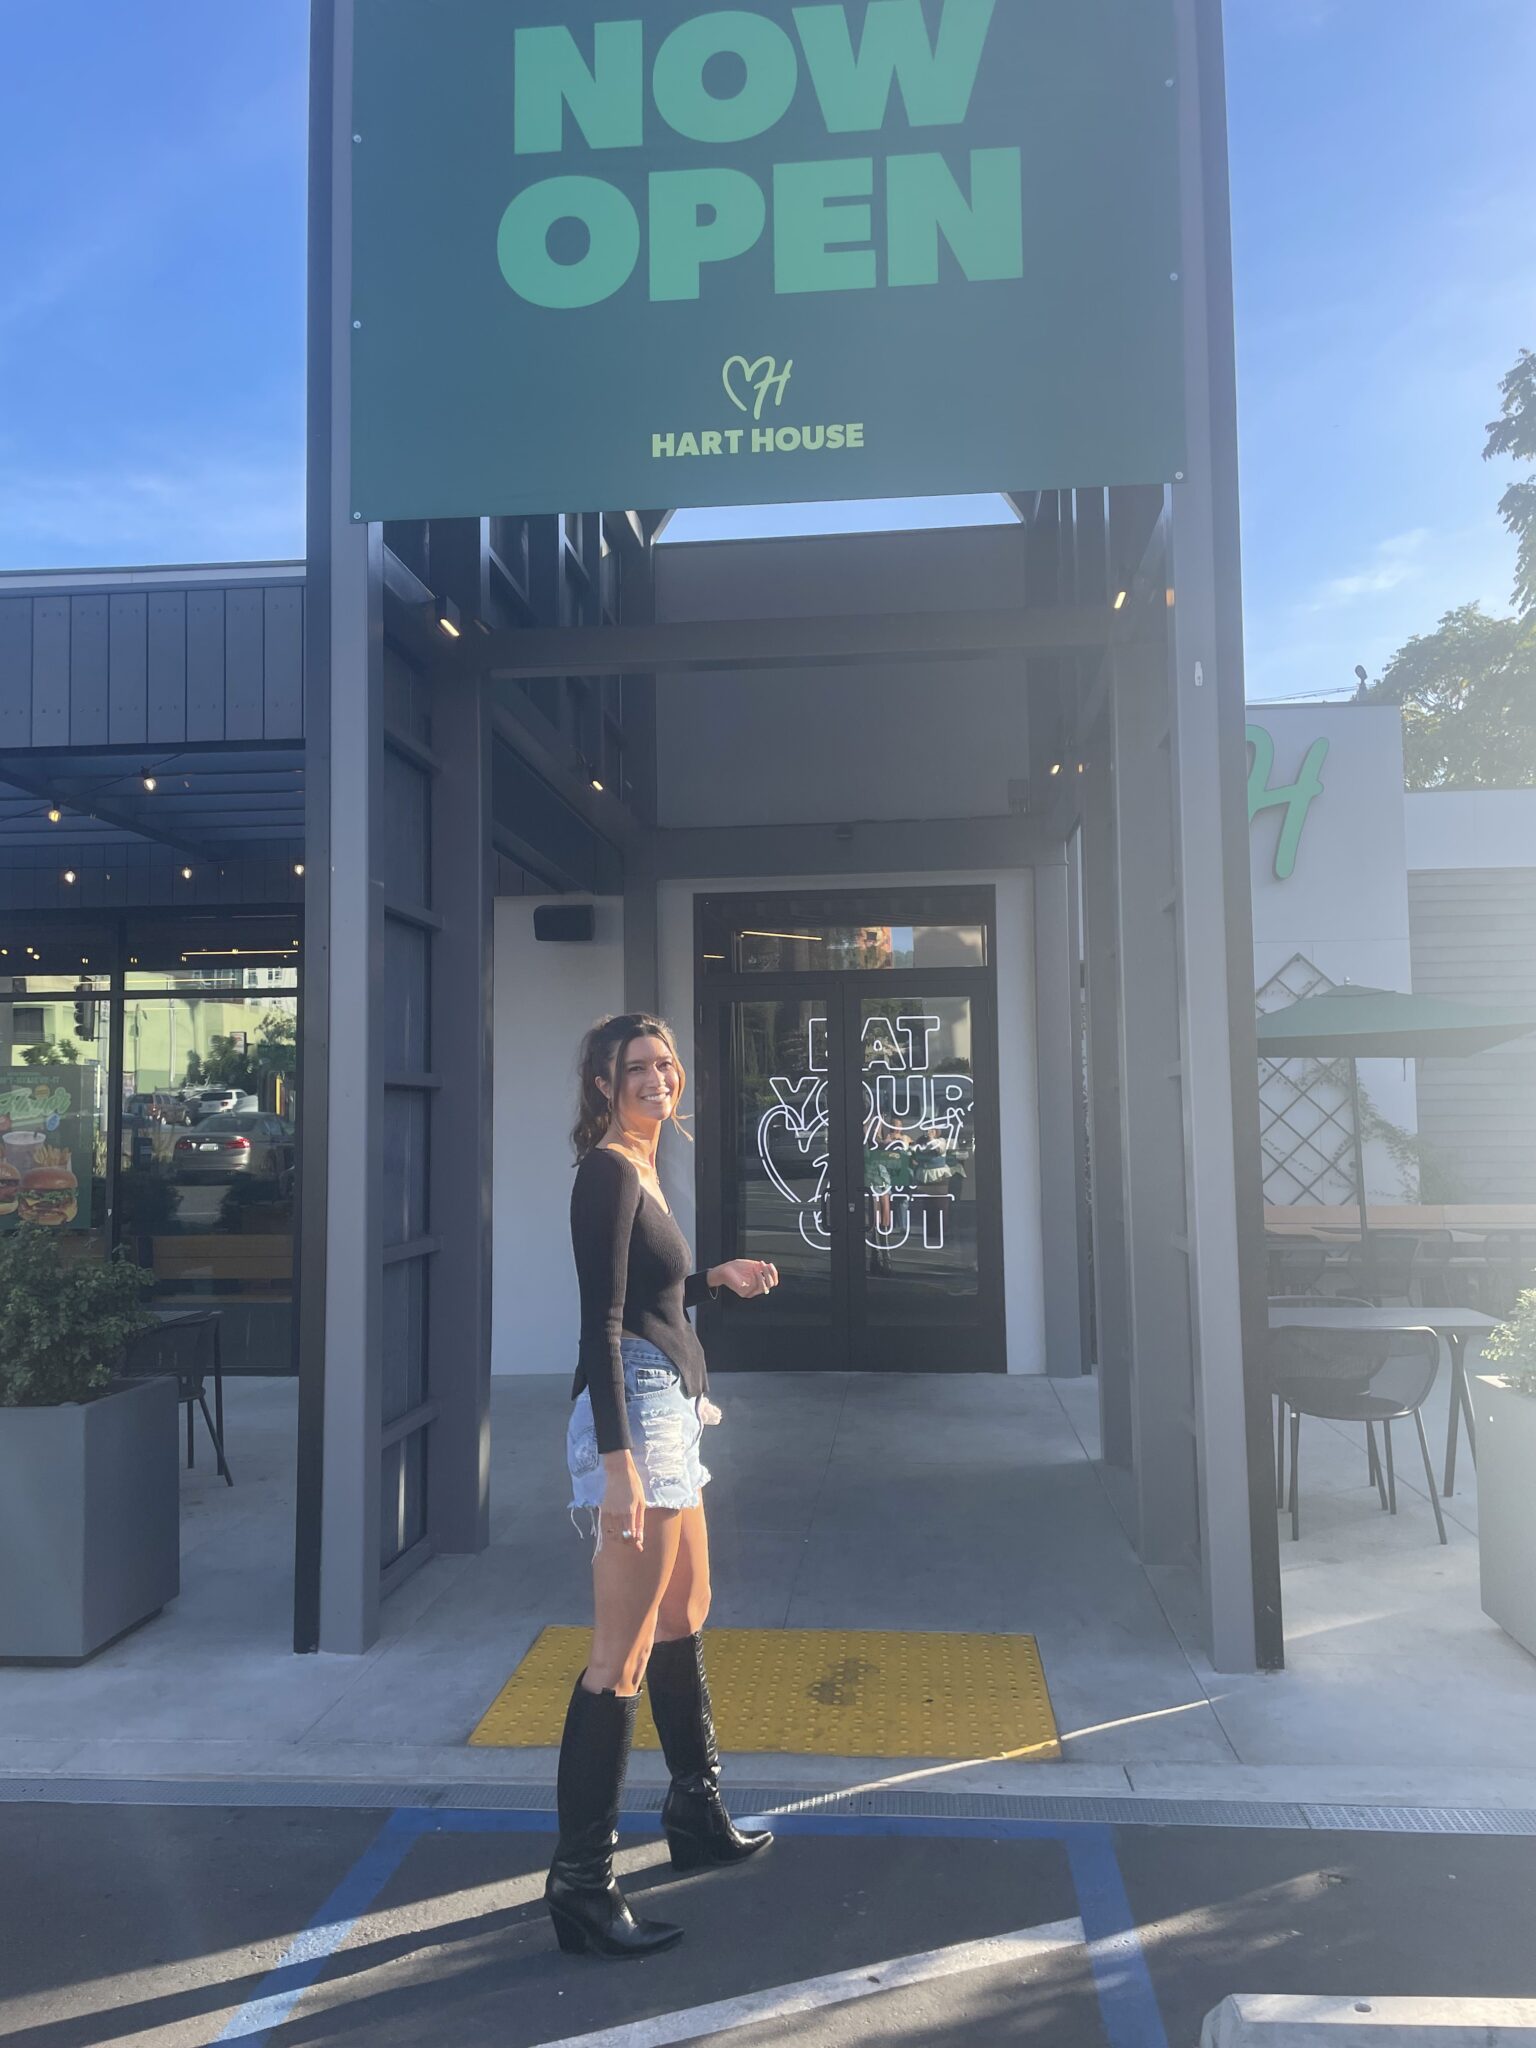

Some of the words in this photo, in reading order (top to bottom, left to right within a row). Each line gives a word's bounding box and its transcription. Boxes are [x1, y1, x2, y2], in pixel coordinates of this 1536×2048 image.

[513, 0, 995, 154] NOW
[497, 147, 1023, 309] OPEN
[652, 430, 744, 457] HART
[751, 423, 864, 452] HOUSE
